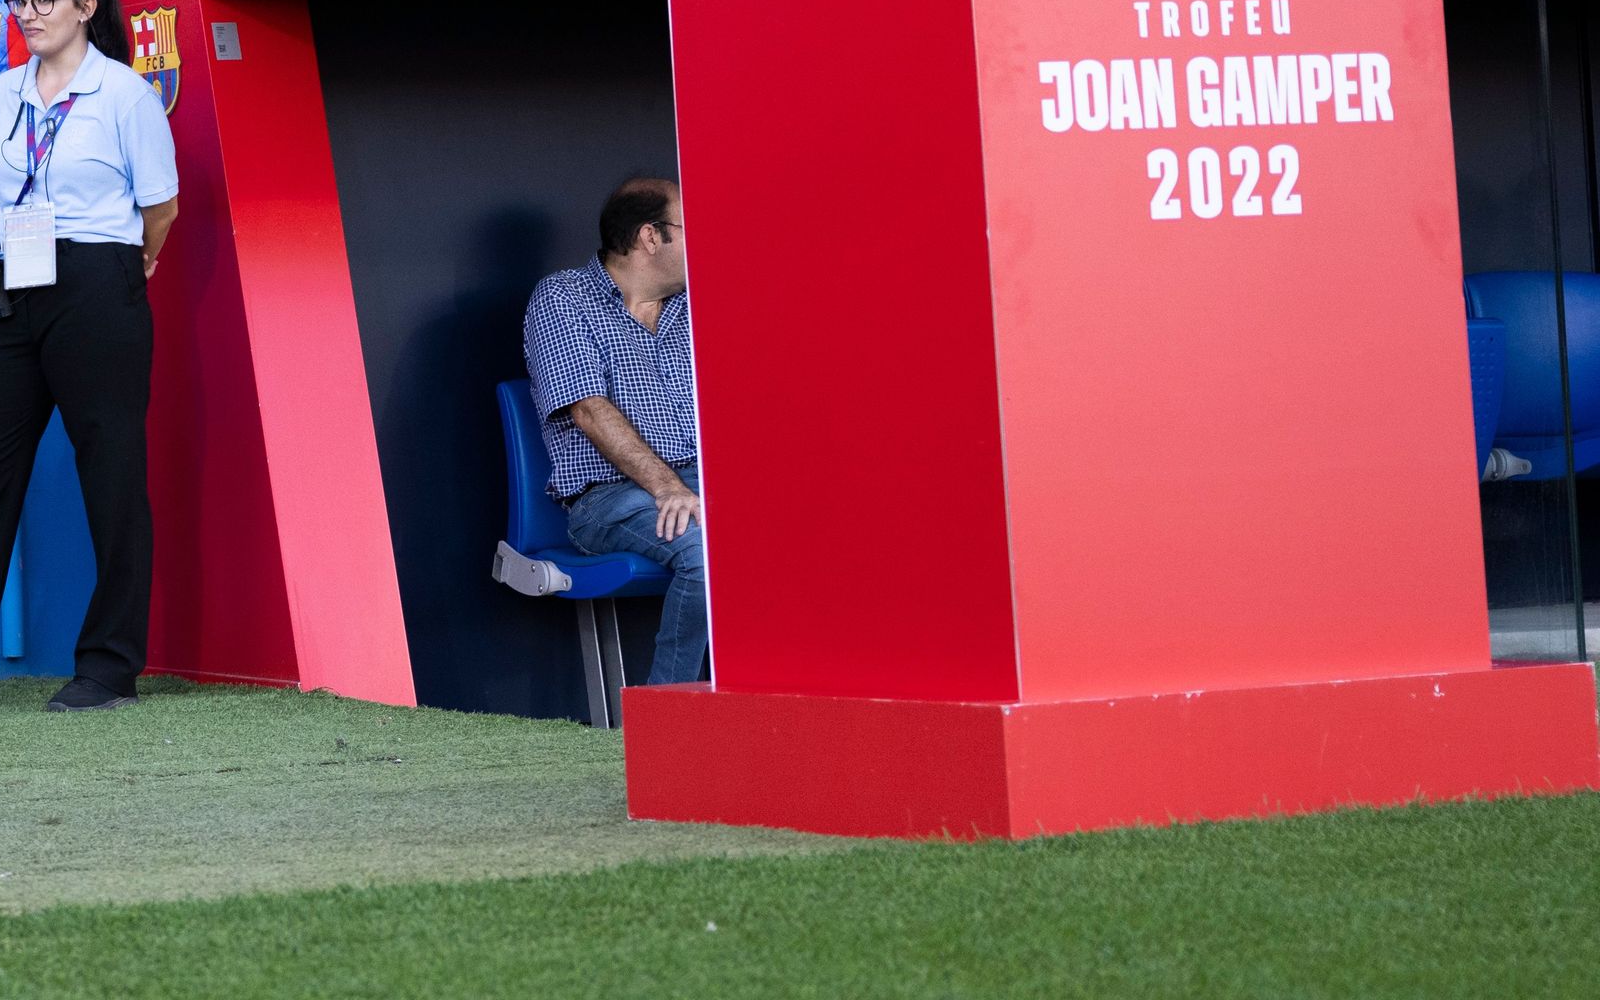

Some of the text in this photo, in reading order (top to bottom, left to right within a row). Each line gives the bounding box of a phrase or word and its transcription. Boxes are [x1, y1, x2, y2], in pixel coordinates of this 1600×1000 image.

[1134, 0, 1290, 38] TROFEU
[146, 56, 165, 71] FCB
[1038, 53, 1394, 132] JOAN GAMPER
[1146, 145, 1303, 220] 2022
